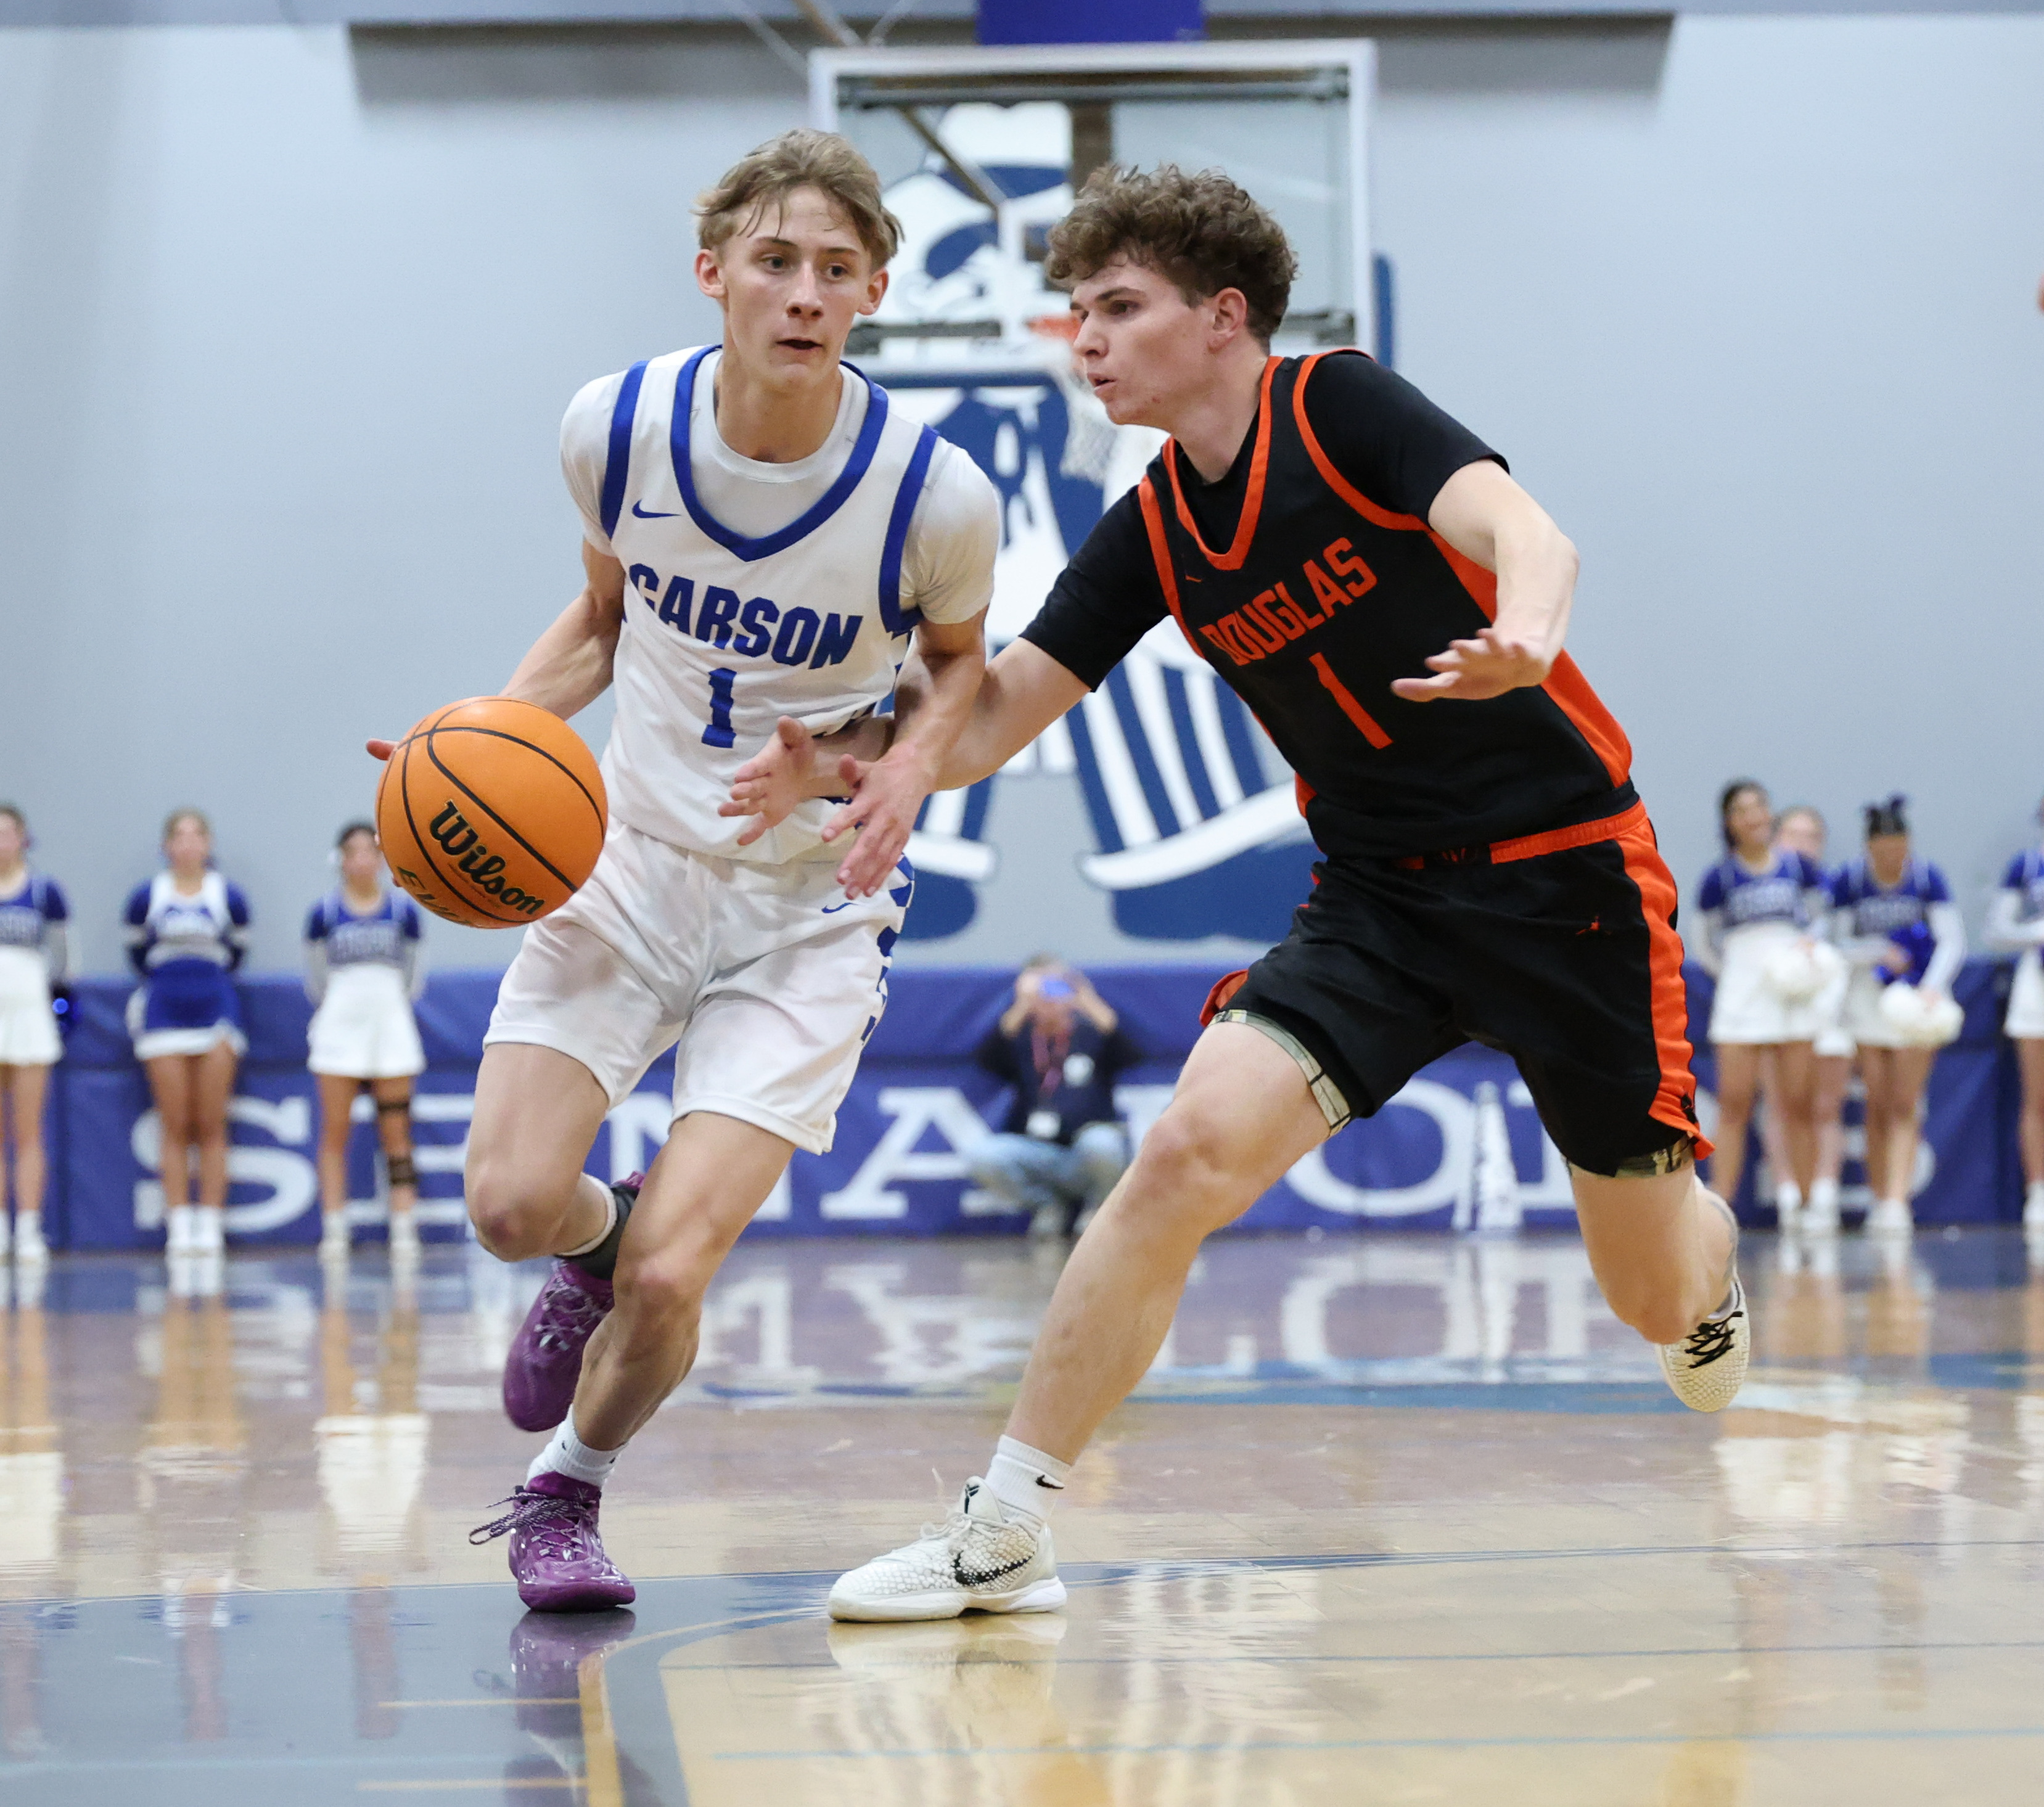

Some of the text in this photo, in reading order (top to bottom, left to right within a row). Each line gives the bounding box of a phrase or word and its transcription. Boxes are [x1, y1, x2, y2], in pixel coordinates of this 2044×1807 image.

[629, 563, 863, 670] CARSON
[1199, 537, 1377, 666] DOUGLAS
[701, 667, 737, 748] 1
[1308, 652, 1393, 749] 1
[429, 799, 544, 915] Wilson
